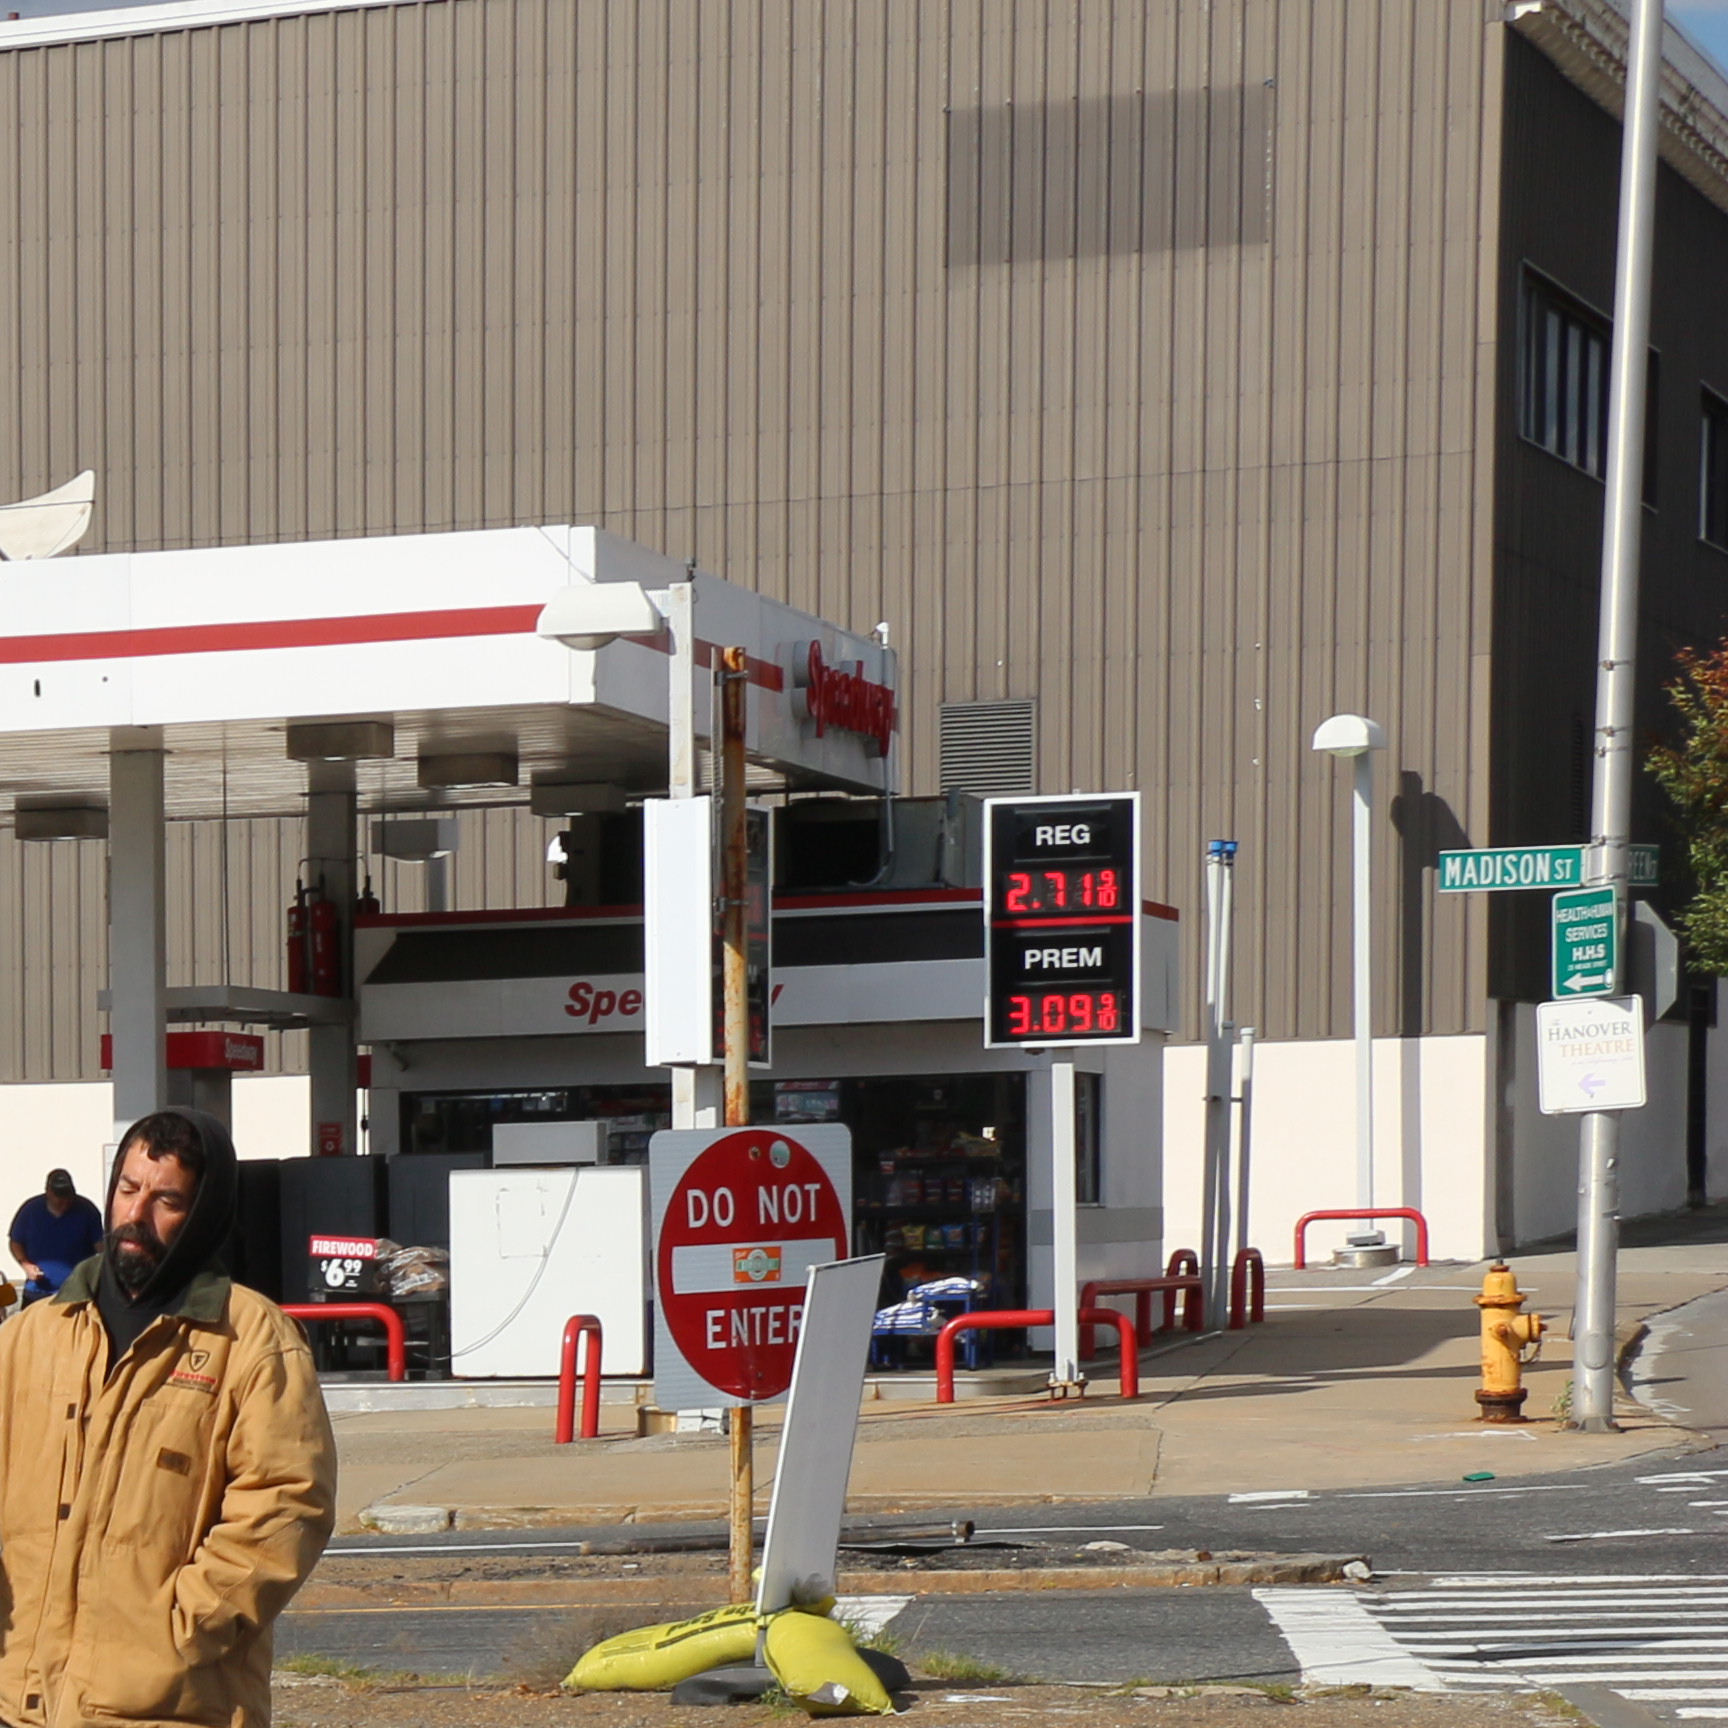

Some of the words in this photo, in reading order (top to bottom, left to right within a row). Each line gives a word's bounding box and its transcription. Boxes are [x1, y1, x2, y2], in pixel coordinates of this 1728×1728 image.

[1035, 823, 1091, 846] REG
[1445, 854, 1551, 887] MADISON
[1554, 859, 1574, 880] ST
[1565, 923, 1608, 942] SERVICES
[1024, 947, 1102, 970] PREM
[1548, 1021, 1632, 1041] HANOVER
[1560, 1038, 1635, 1057] THEATRE
[687, 1187, 734, 1228] DO
[758, 1184, 821, 1225] NOT
[312, 1240, 373, 1256] FIREWOOD
[706, 1304, 802, 1350] ENTER
